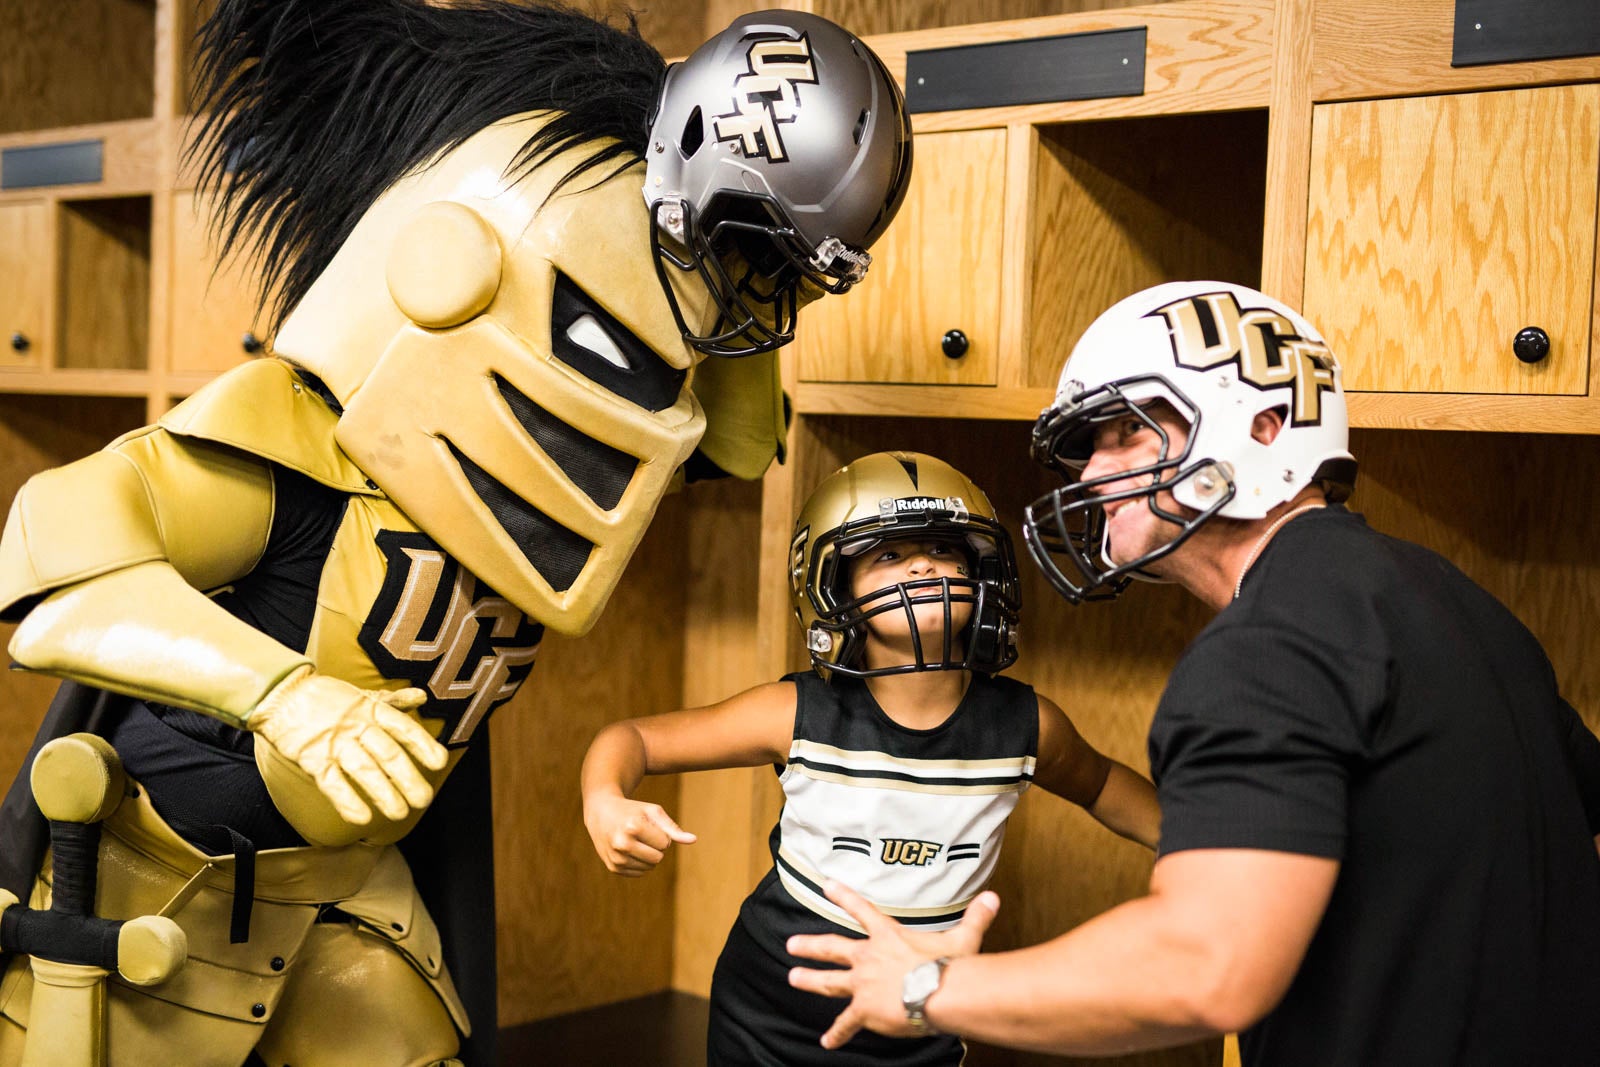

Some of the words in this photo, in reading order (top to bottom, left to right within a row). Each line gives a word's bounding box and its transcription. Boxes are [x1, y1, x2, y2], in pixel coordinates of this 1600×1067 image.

[712, 30, 819, 163] UCF
[1141, 291, 1336, 428] UCF
[896, 498, 945, 511] Riddell
[379, 547, 541, 745] UCF
[879, 838, 943, 866] UCF
